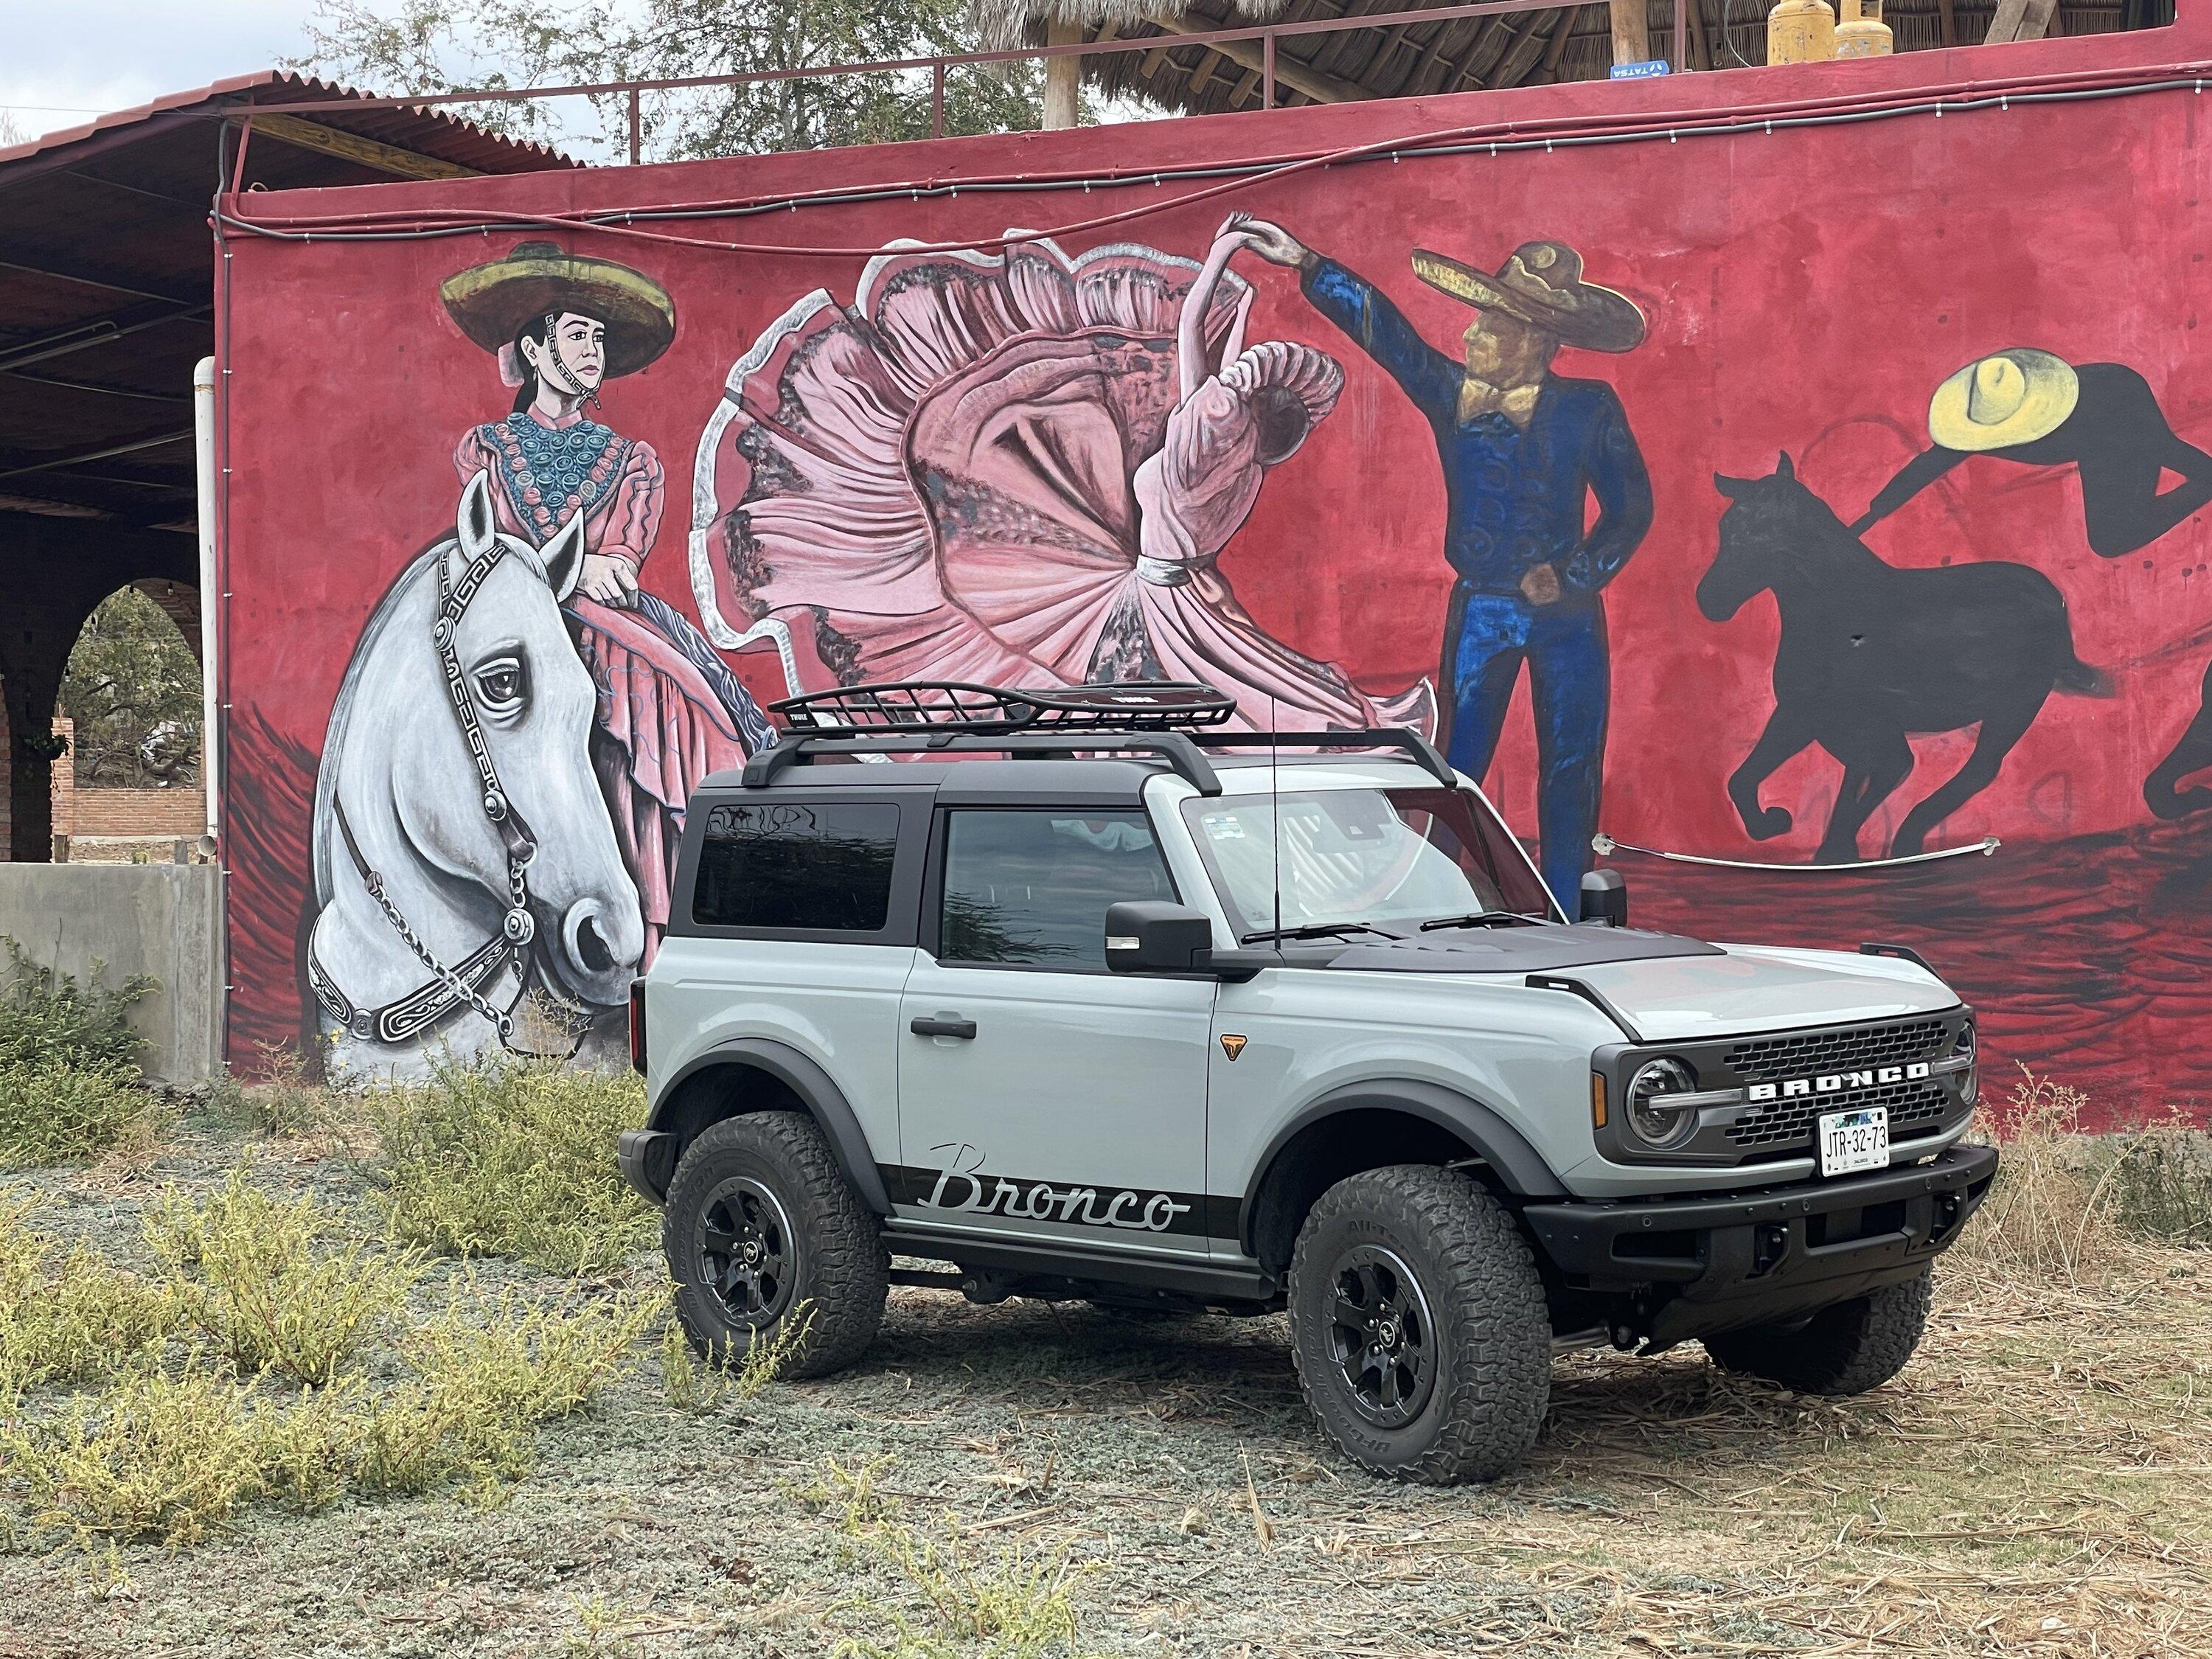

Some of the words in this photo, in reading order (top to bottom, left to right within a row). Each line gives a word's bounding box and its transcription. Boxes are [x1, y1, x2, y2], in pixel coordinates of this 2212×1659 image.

[1613, 67, 1648, 77] TATSA
[1749, 1062, 1929, 1101] BRONCO
[1826, 1125, 1886, 1158] JTR-32-73
[917, 1143, 1191, 1231] Bronco
[1304, 1314, 1392, 1453] BFGoodrich
